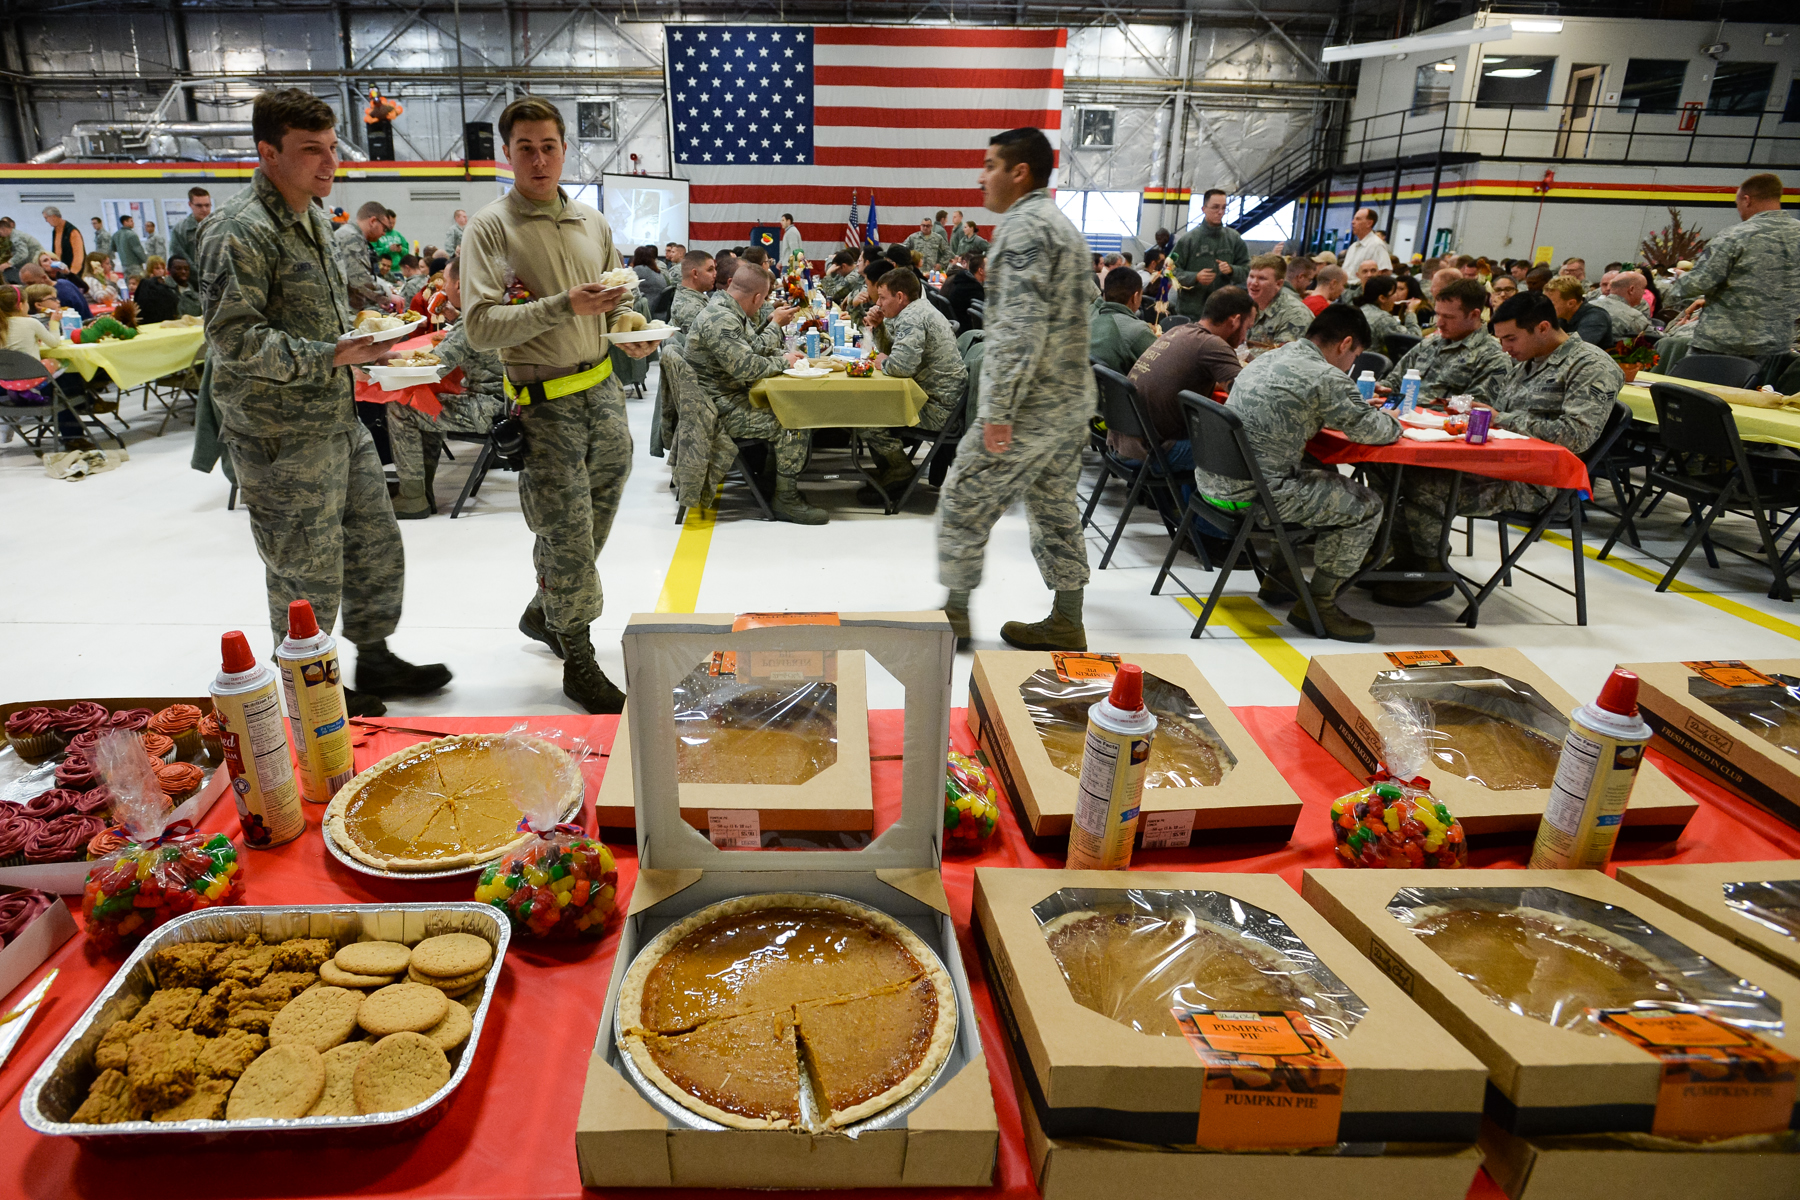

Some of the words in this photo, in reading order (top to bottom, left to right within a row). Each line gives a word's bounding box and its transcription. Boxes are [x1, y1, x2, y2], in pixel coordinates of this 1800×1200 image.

[1358, 722, 1371, 741] Daily
[1689, 721, 1709, 739] Daily
[1708, 733, 1729, 749] Chef
[1338, 724, 1355, 745] FRESH
[1353, 741, 1371, 764] BAKED
[1661, 726, 1685, 745] FRESH
[1684, 741, 1711, 762] BAKED
[1710, 758, 1721, 768] IN
[1720, 765, 1743, 783] CLUB
[1212, 1023, 1279, 1033] PUMPKIN
[1224, 1093, 1293, 1108] PUMPKIN
[1295, 1097, 1319, 1109] PIE
